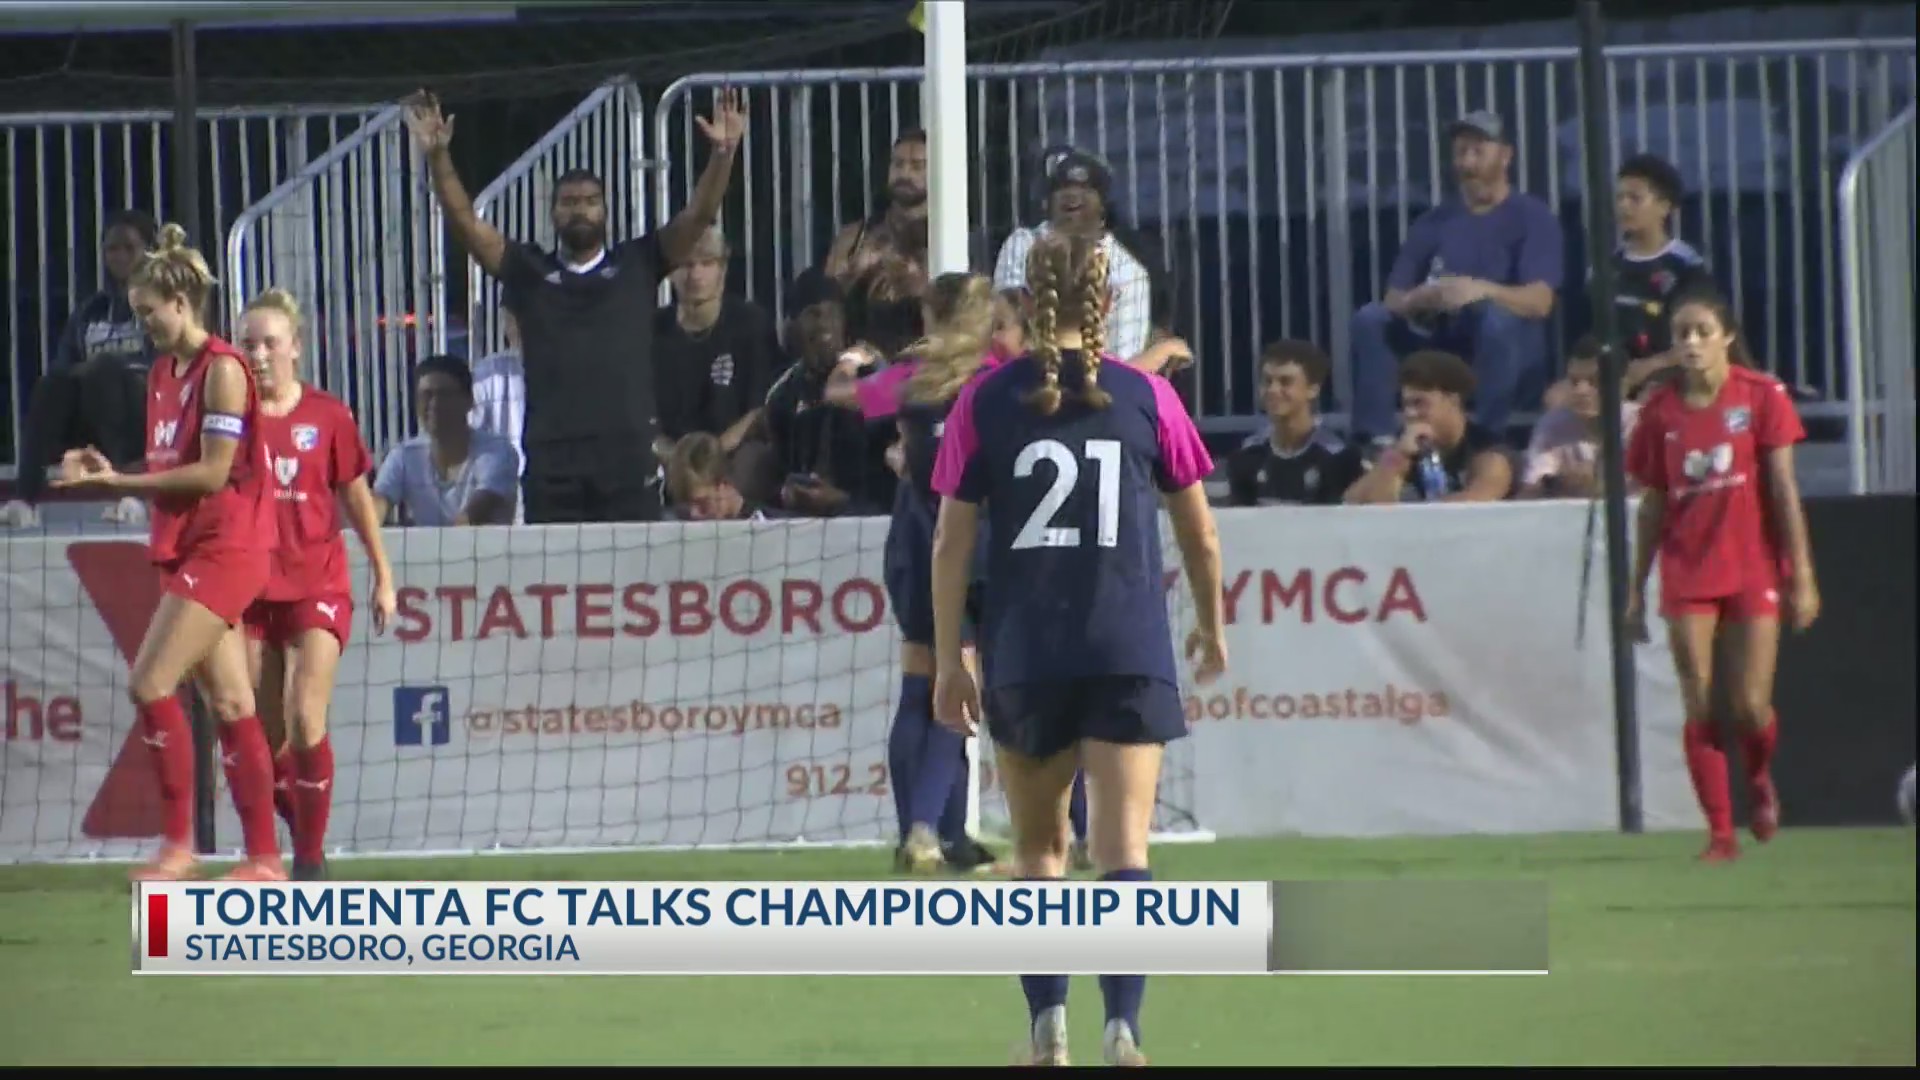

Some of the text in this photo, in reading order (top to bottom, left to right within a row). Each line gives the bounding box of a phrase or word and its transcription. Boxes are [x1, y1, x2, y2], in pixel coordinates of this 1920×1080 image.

[1010, 438, 1121, 549] 21
[394, 565, 1428, 643] STATESBORO YMCA
[0, 679, 83, 742] he
[465, 699, 842, 737] @statesboroymca
[1185, 684, 1449, 725] aofcoastalga
[786, 763, 889, 797] 912.2
